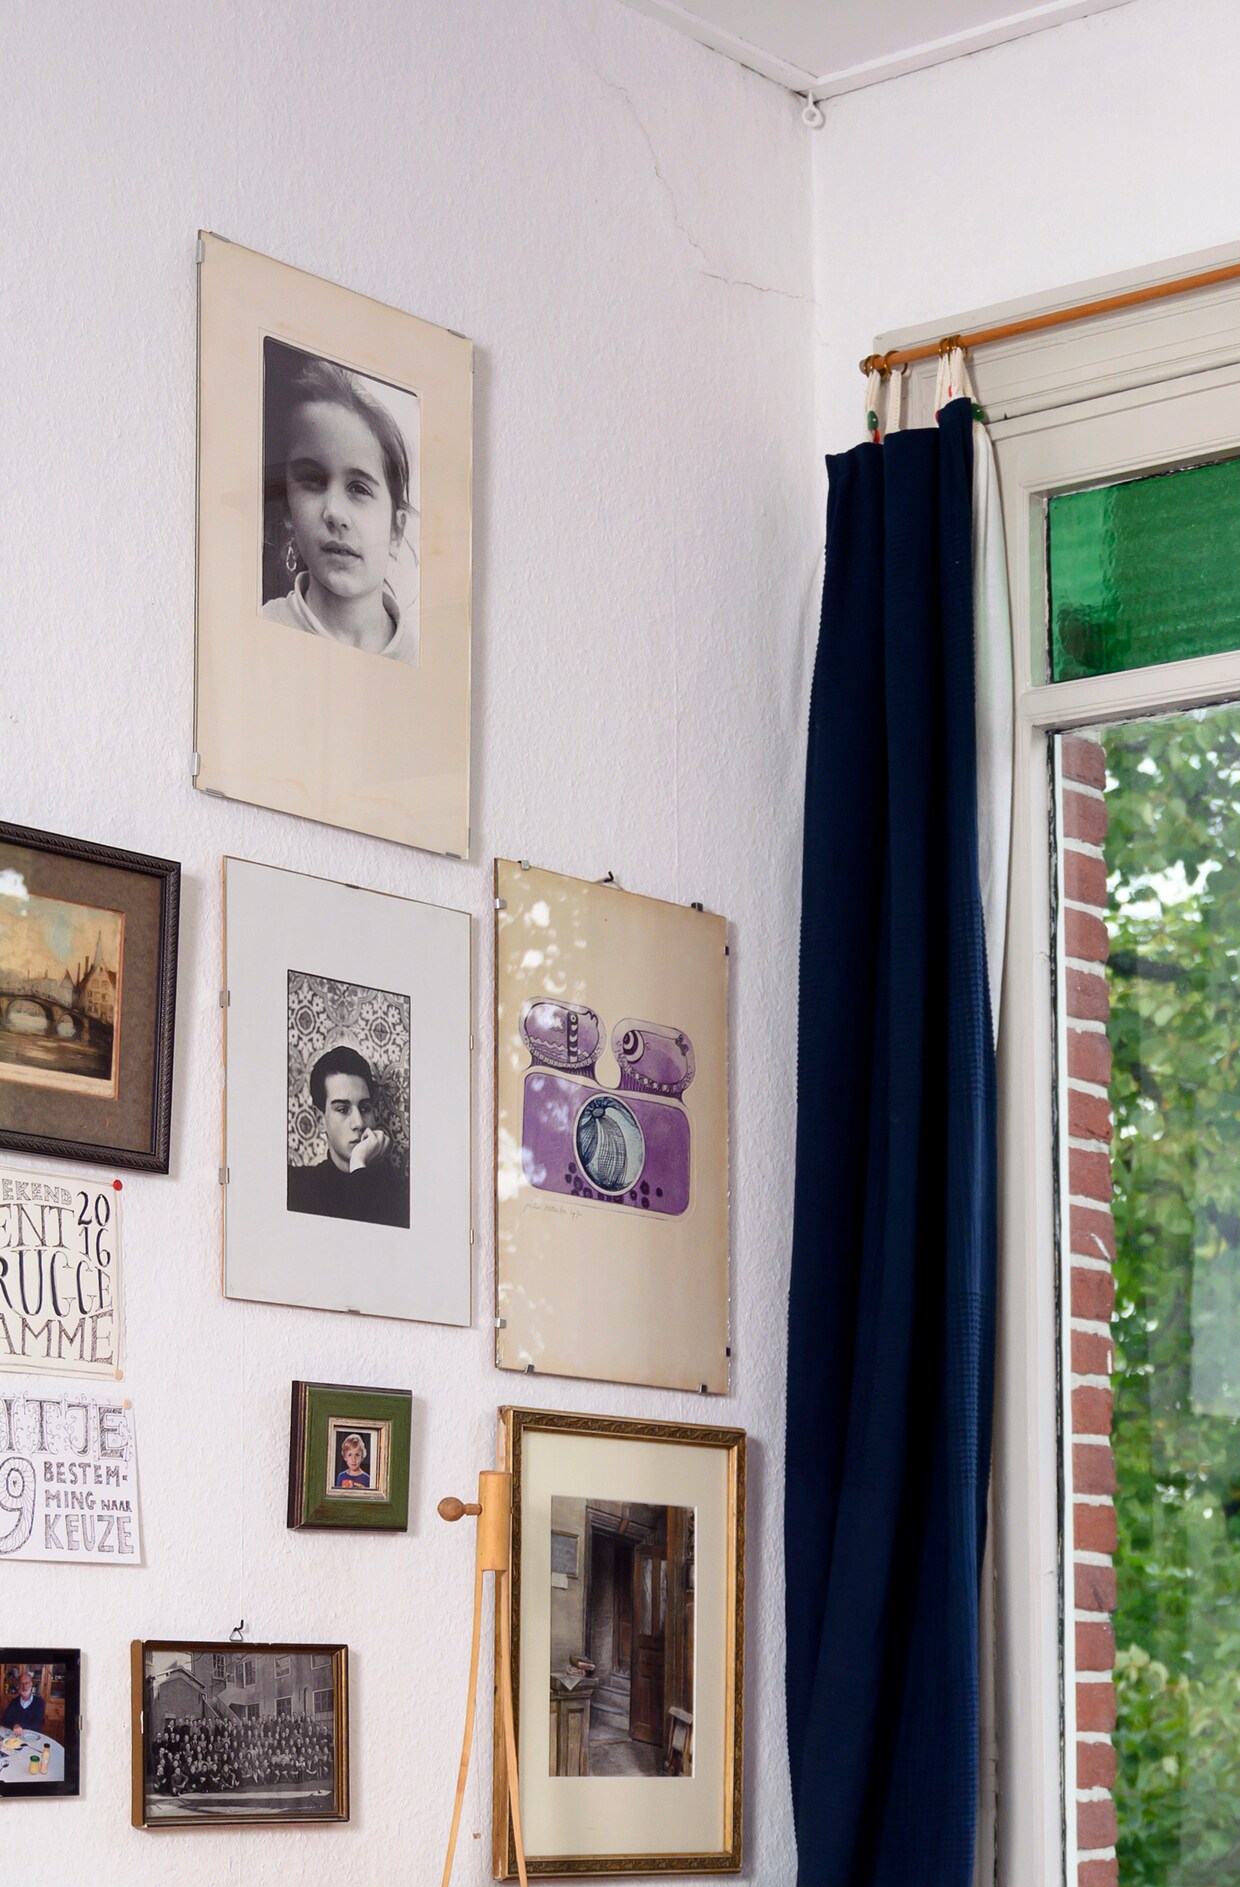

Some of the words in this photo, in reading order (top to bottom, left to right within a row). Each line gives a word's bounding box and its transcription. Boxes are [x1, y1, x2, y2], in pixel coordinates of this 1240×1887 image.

[2, 1178, 73, 1206] EKEND
[77, 1191, 110, 1226] 20
[79, 1227, 110, 1267] 16
[0, 1457, 36, 1554] 9
[44, 1489, 96, 1511] MING
[101, 1500, 133, 1513] NAAR
[44, 1513, 134, 1554] KEUZE
